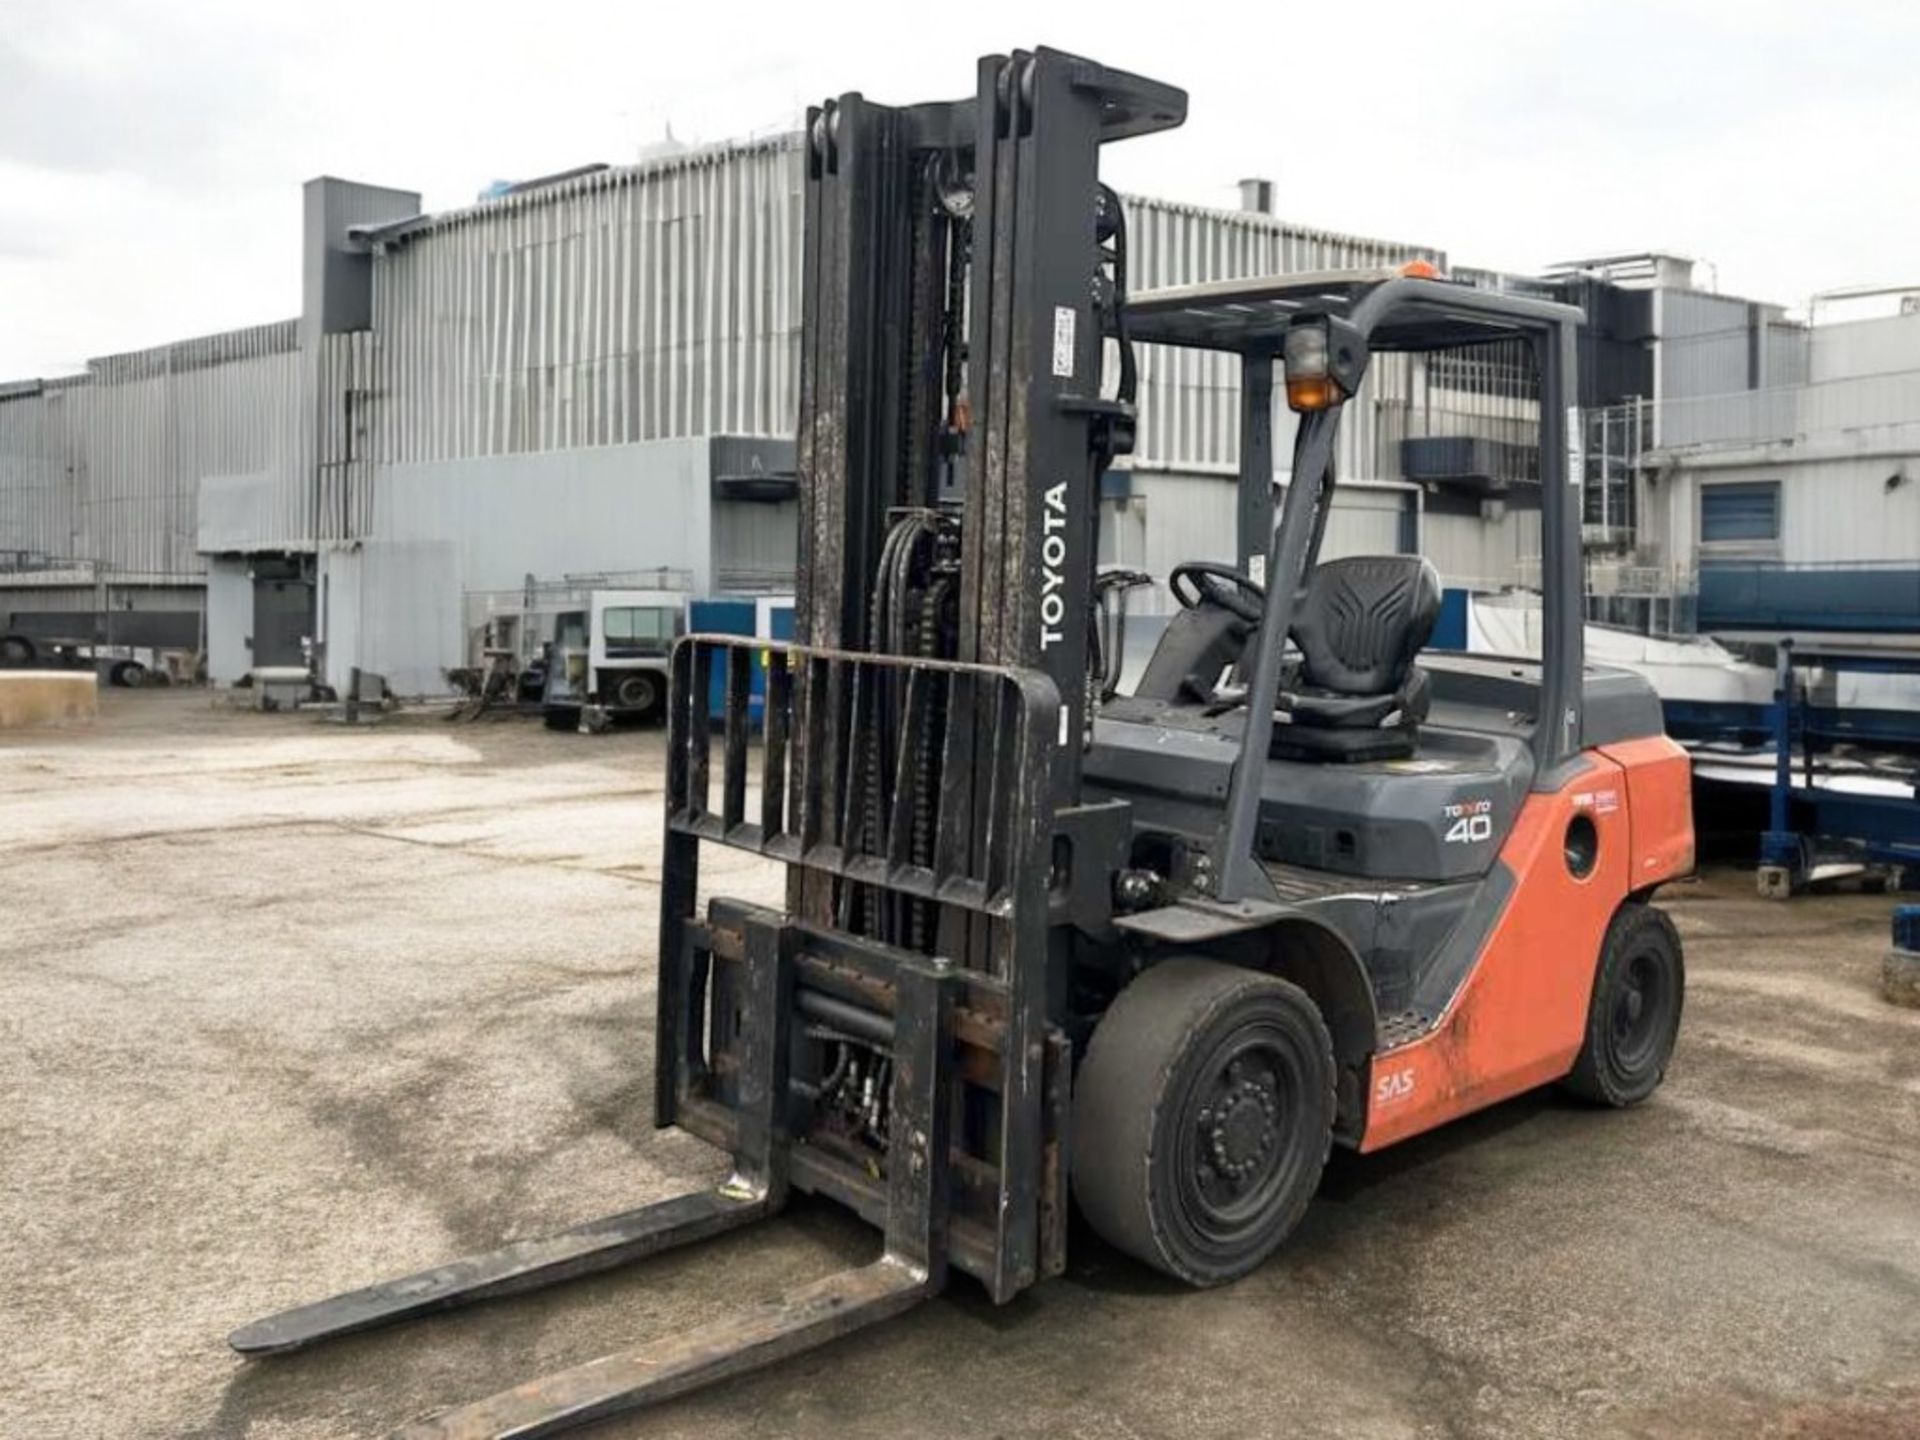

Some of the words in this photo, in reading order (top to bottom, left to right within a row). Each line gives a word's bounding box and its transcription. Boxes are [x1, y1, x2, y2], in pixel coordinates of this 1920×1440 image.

[1040, 481, 1068, 651] TOYOTA
[1444, 814, 1491, 844] 40
[1376, 1068, 1415, 1100] SAS
